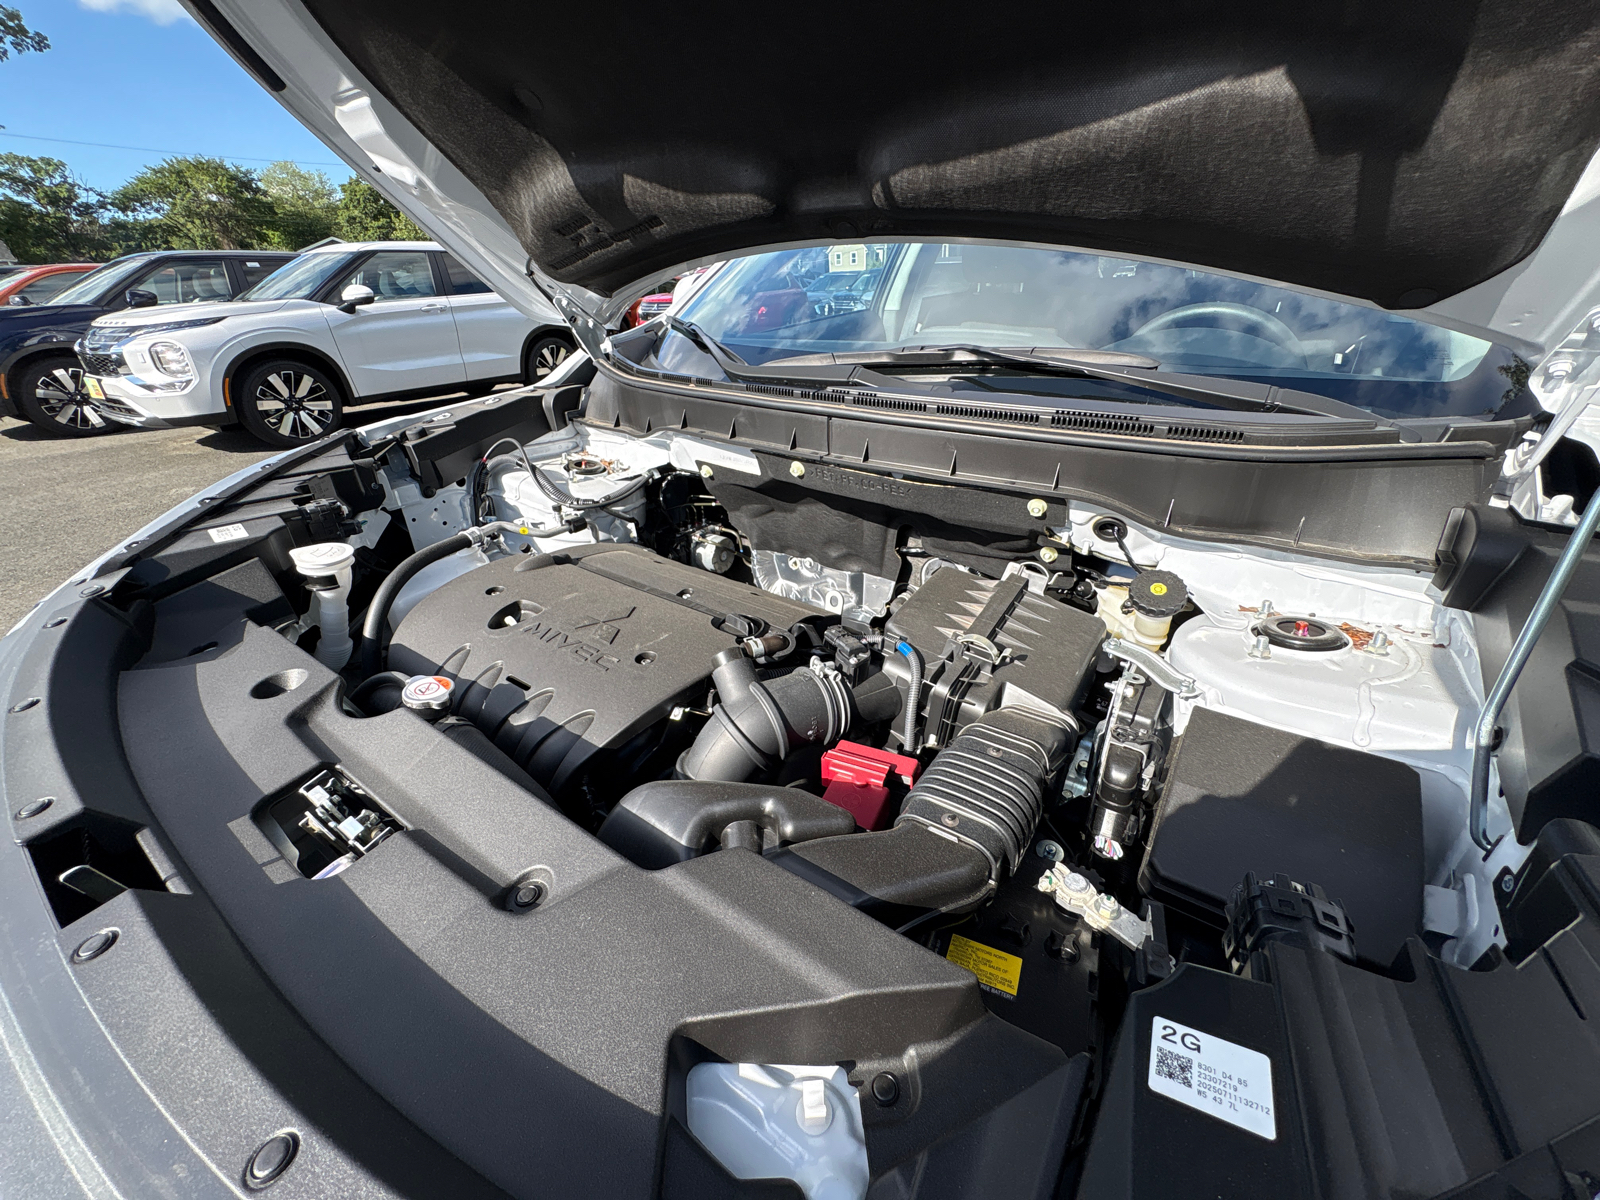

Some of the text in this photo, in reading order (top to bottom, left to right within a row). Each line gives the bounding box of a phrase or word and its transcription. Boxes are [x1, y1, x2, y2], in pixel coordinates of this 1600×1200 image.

[522, 622, 622, 672] MIVEC
[990, 986, 1014, 1000] BATTERY
[1160, 1025, 1201, 1054] 2G
[1197, 1070, 1238, 1092] 23307219
[1197, 1080, 1270, 1115] 20250711132712
[1212, 1096, 1222, 1106] 43
